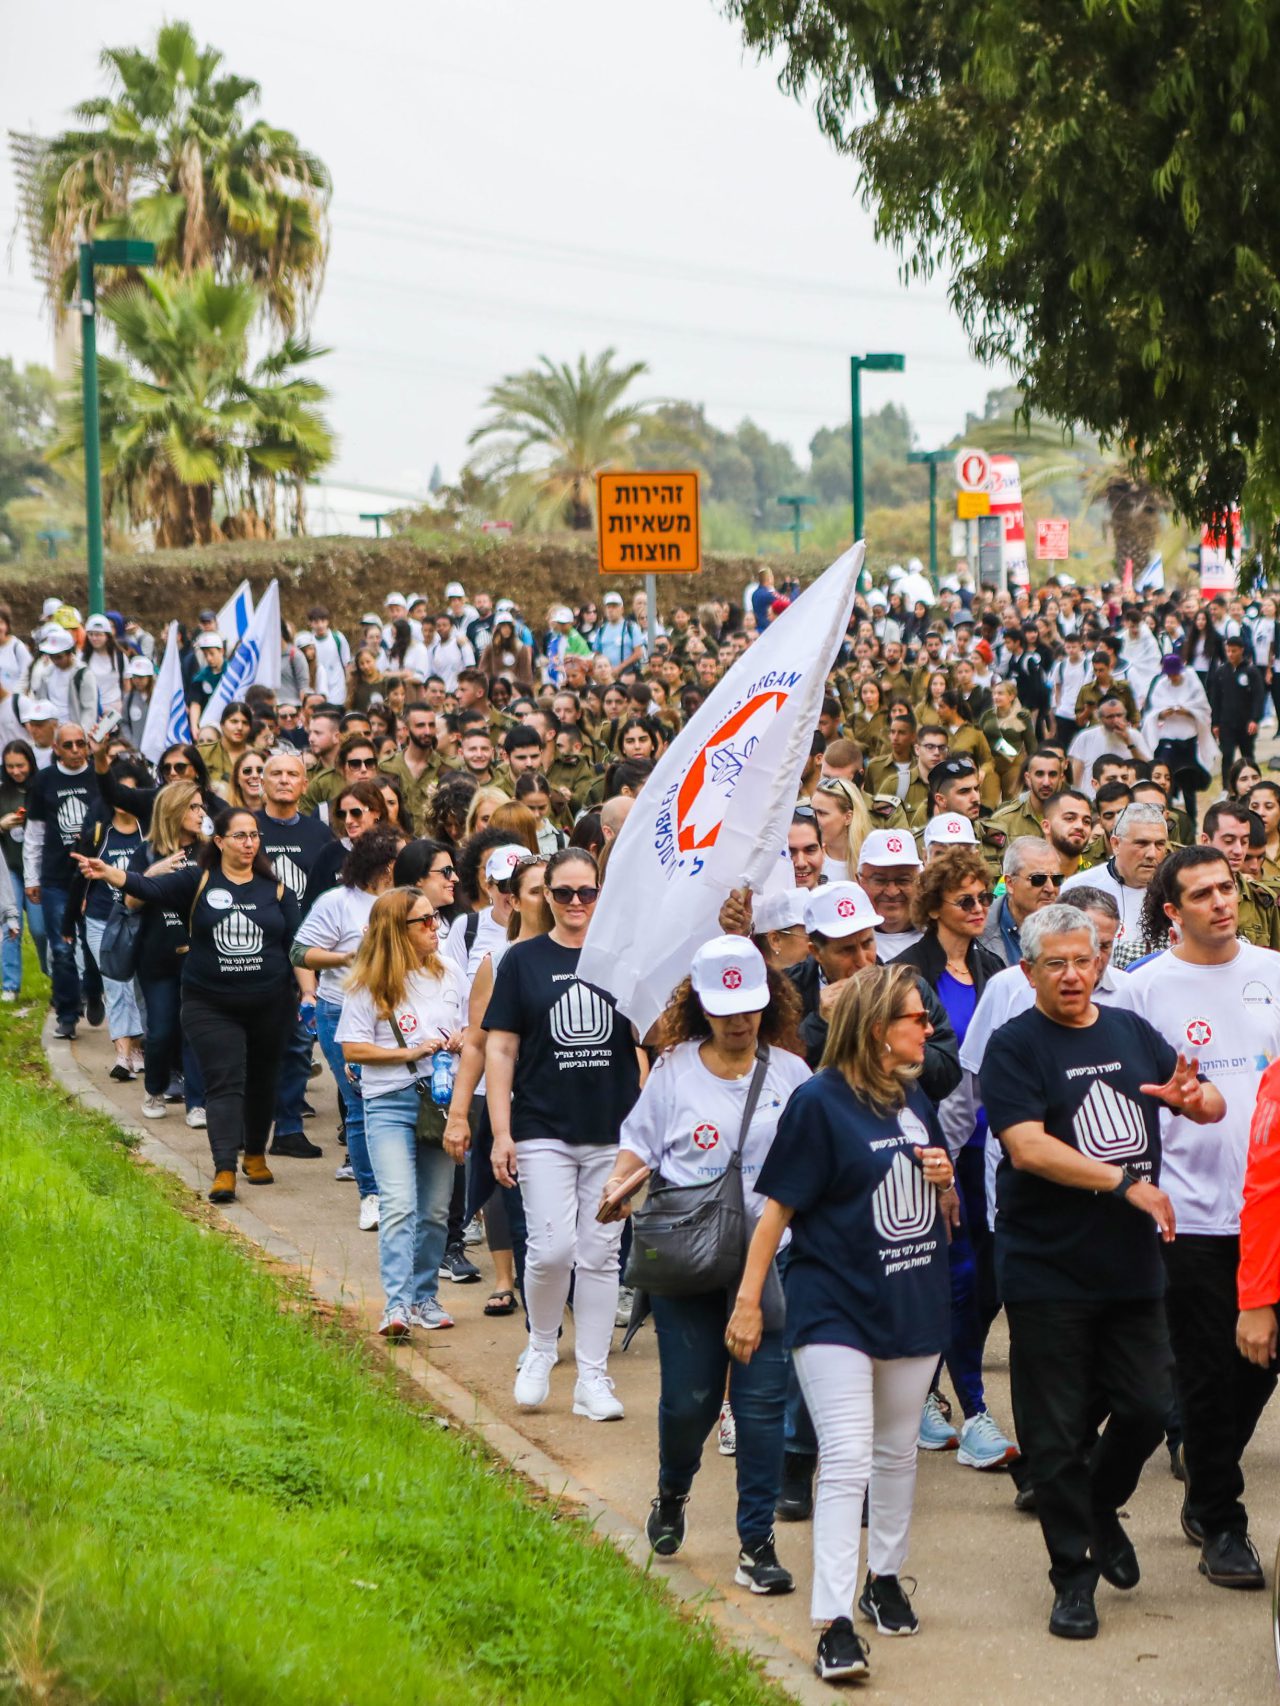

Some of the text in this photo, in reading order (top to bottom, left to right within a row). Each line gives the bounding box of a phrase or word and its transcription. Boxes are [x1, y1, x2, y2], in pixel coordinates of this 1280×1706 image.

[616, 486, 683, 504] זהירות
[609, 515, 691, 533] משאיות
[620, 543, 681, 561] חוצות
[575, 1049, 591, 1058] לנכי
[591, 1049, 612, 1058] מצדיע
[559, 1060, 588, 1071] הביטחון
[1232, 1057, 1247, 1068] יום
[1066, 1061, 1122, 1080] משרד הביטחון
